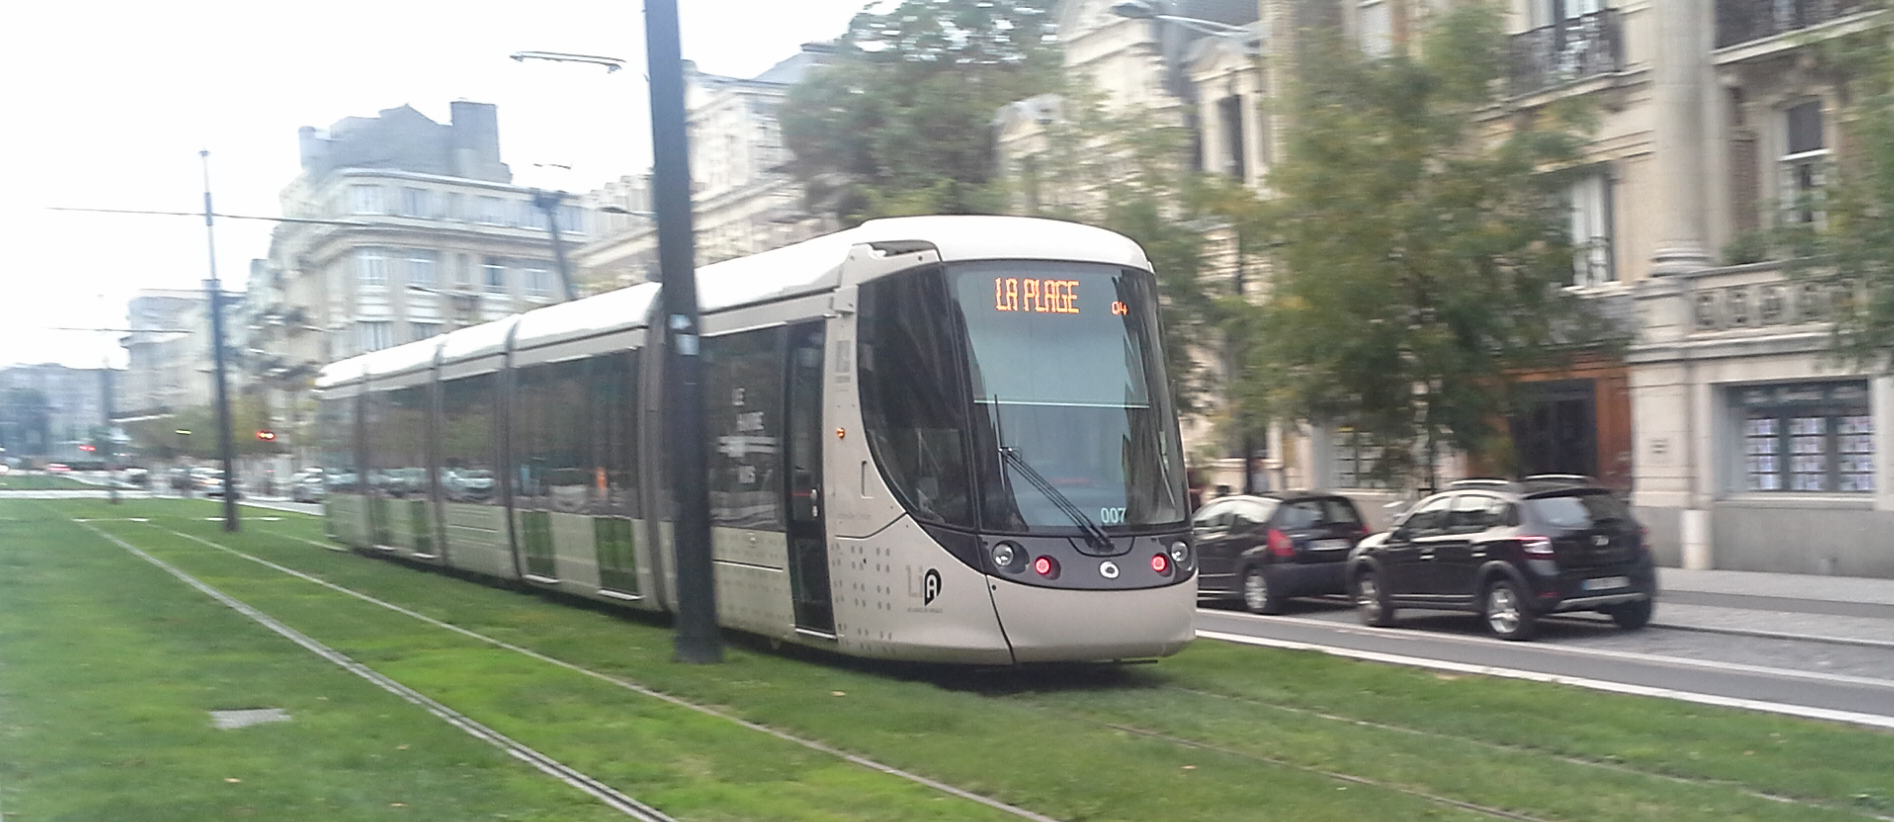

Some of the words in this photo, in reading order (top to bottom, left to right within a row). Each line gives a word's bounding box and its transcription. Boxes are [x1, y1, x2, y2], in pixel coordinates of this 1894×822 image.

[994, 277, 1018, 312] LA
[1023, 278, 1080, 314] PLAGE
[1111, 301, 1129, 316] 04
[1100, 507, 1127, 524] 007
